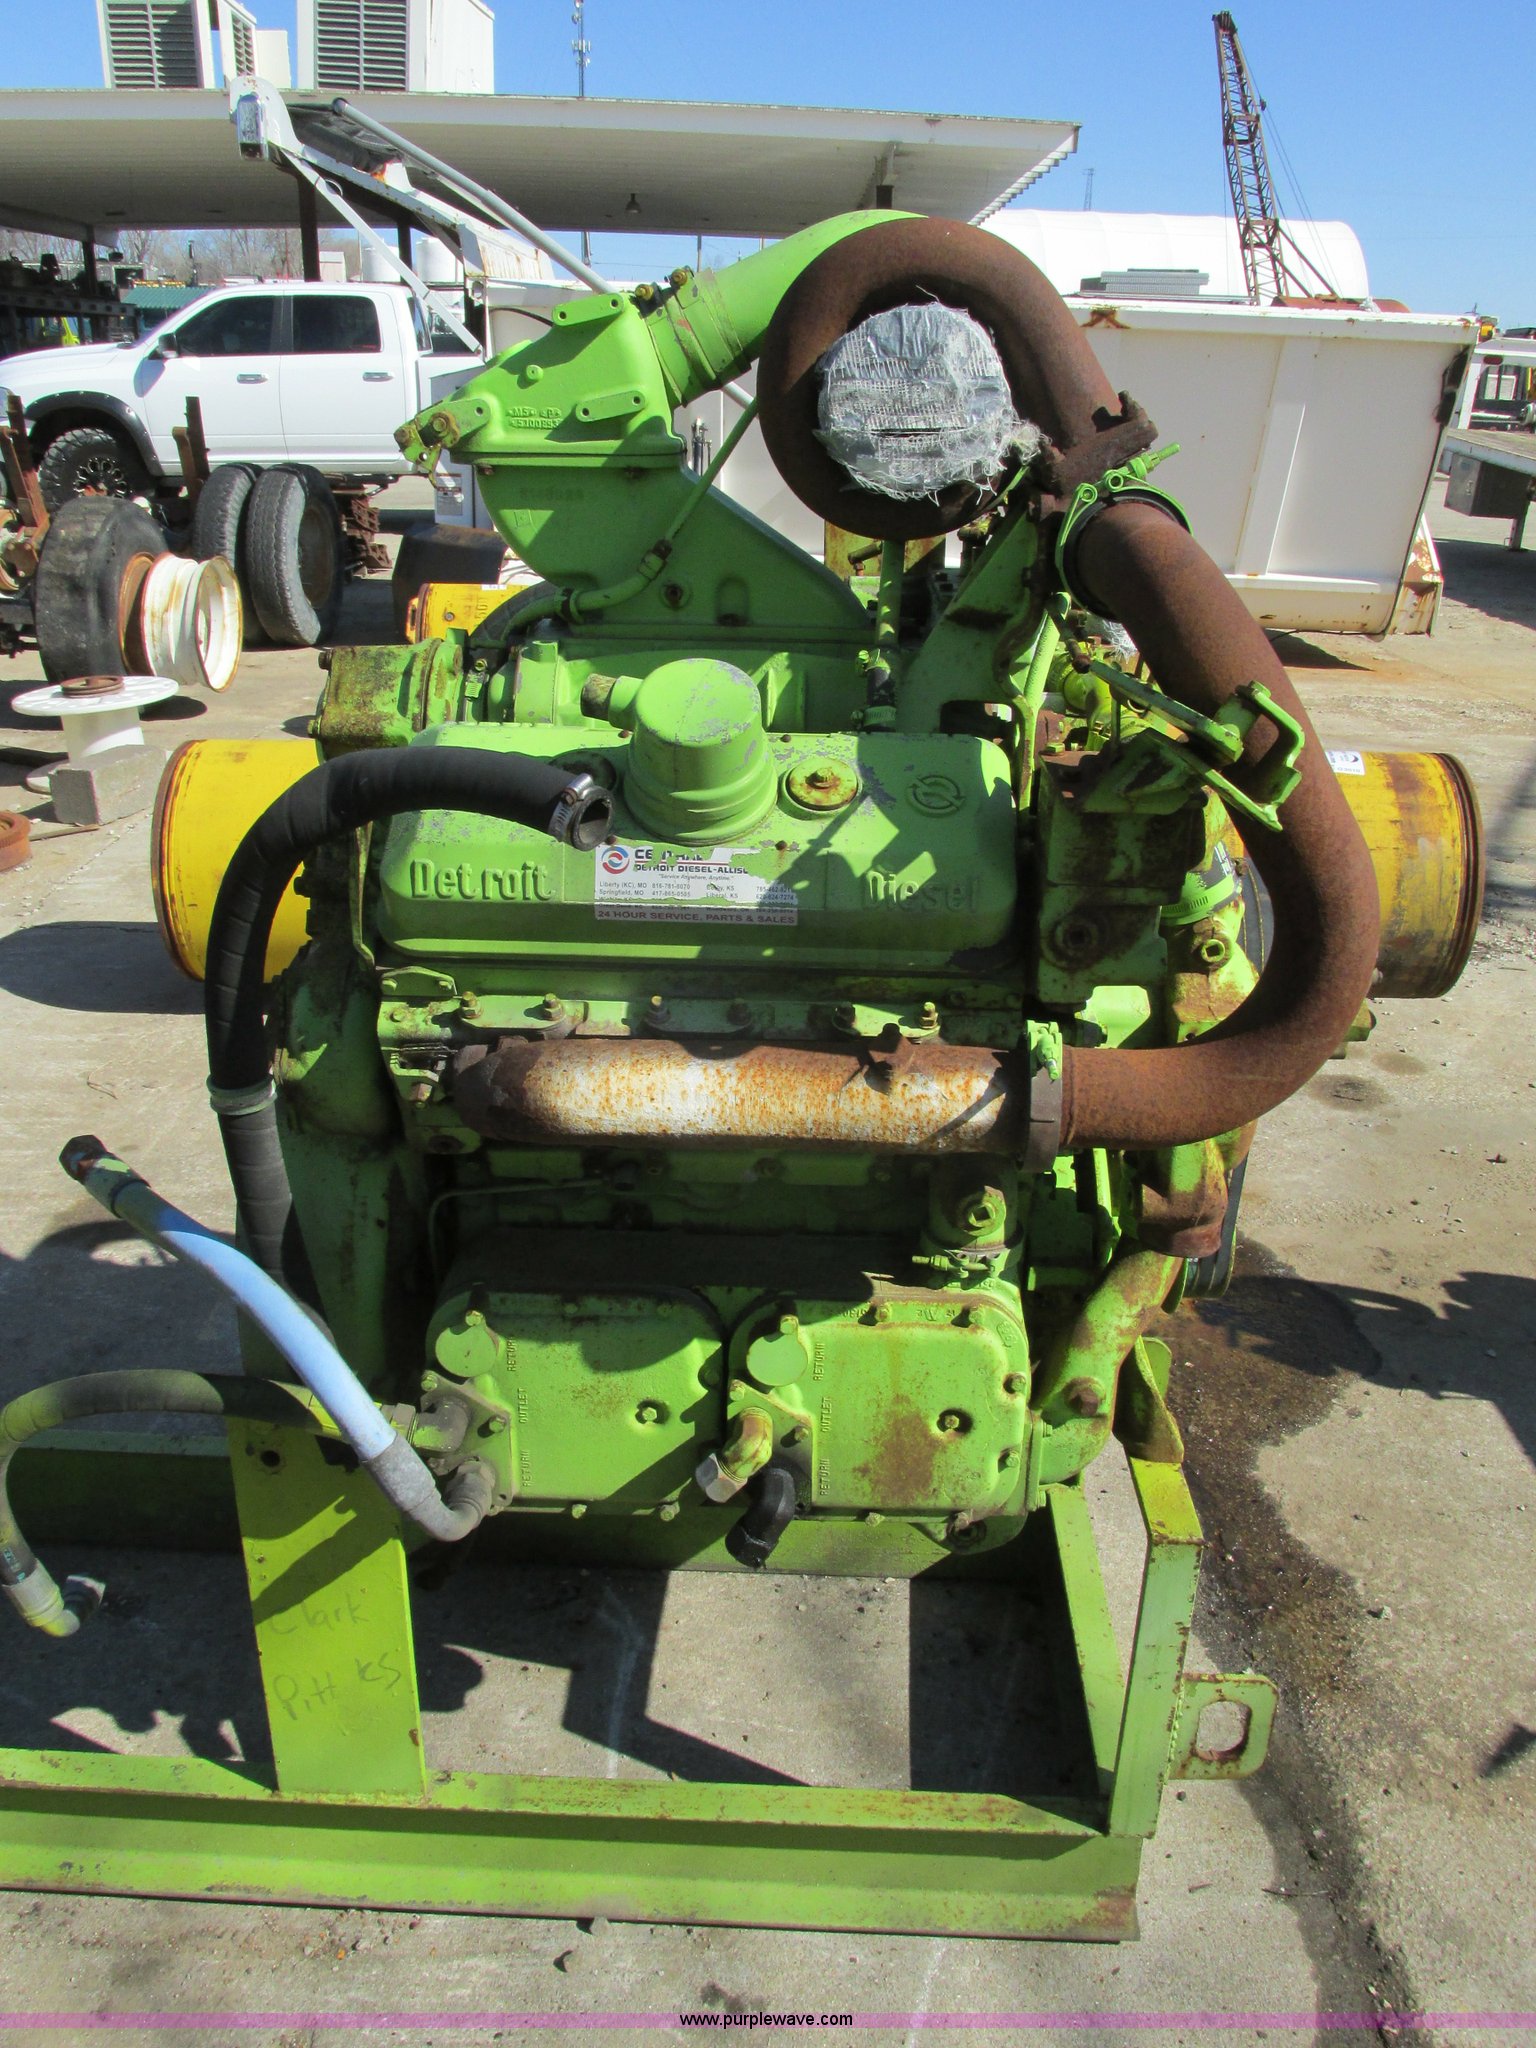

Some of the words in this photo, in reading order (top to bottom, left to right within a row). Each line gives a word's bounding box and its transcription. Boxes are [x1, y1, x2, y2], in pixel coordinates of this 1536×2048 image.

[410, 858, 556, 901] Detroit
[863, 870, 979, 913] Diesel
[706, 914, 743, 922] PARTS
[758, 916, 795, 924] SALES
[517, 1387, 529, 1424] OUTLET
[820, 1396, 832, 1433] OUTLET
[270, 1593, 370, 1635] Clark
[355, 1652, 402, 1692] KS
